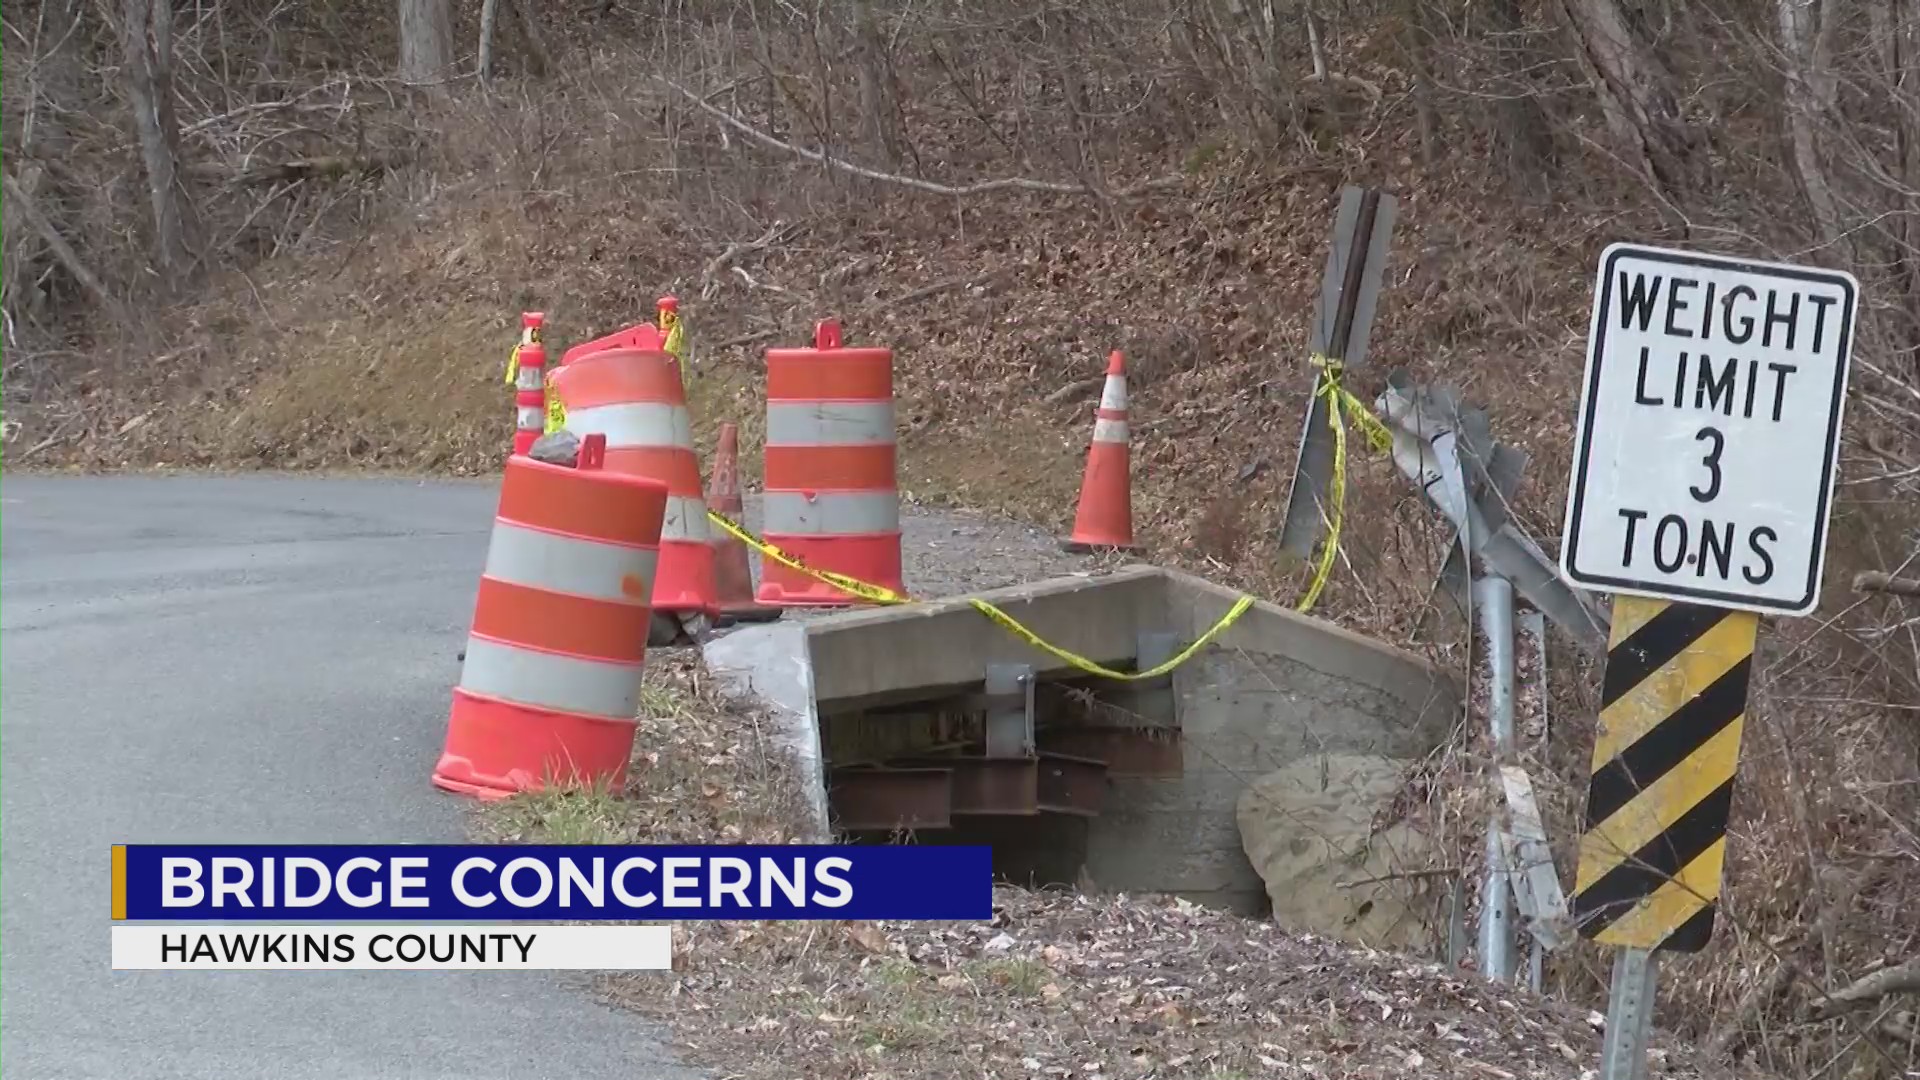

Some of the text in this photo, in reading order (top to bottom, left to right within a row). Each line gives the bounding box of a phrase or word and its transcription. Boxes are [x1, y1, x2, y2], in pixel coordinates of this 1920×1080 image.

[1619, 271, 1838, 354] WEIGHT
[1634, 346, 1797, 422] LIMIT
[1689, 426, 1725, 503] 3
[1618, 508, 1778, 585] TONS
